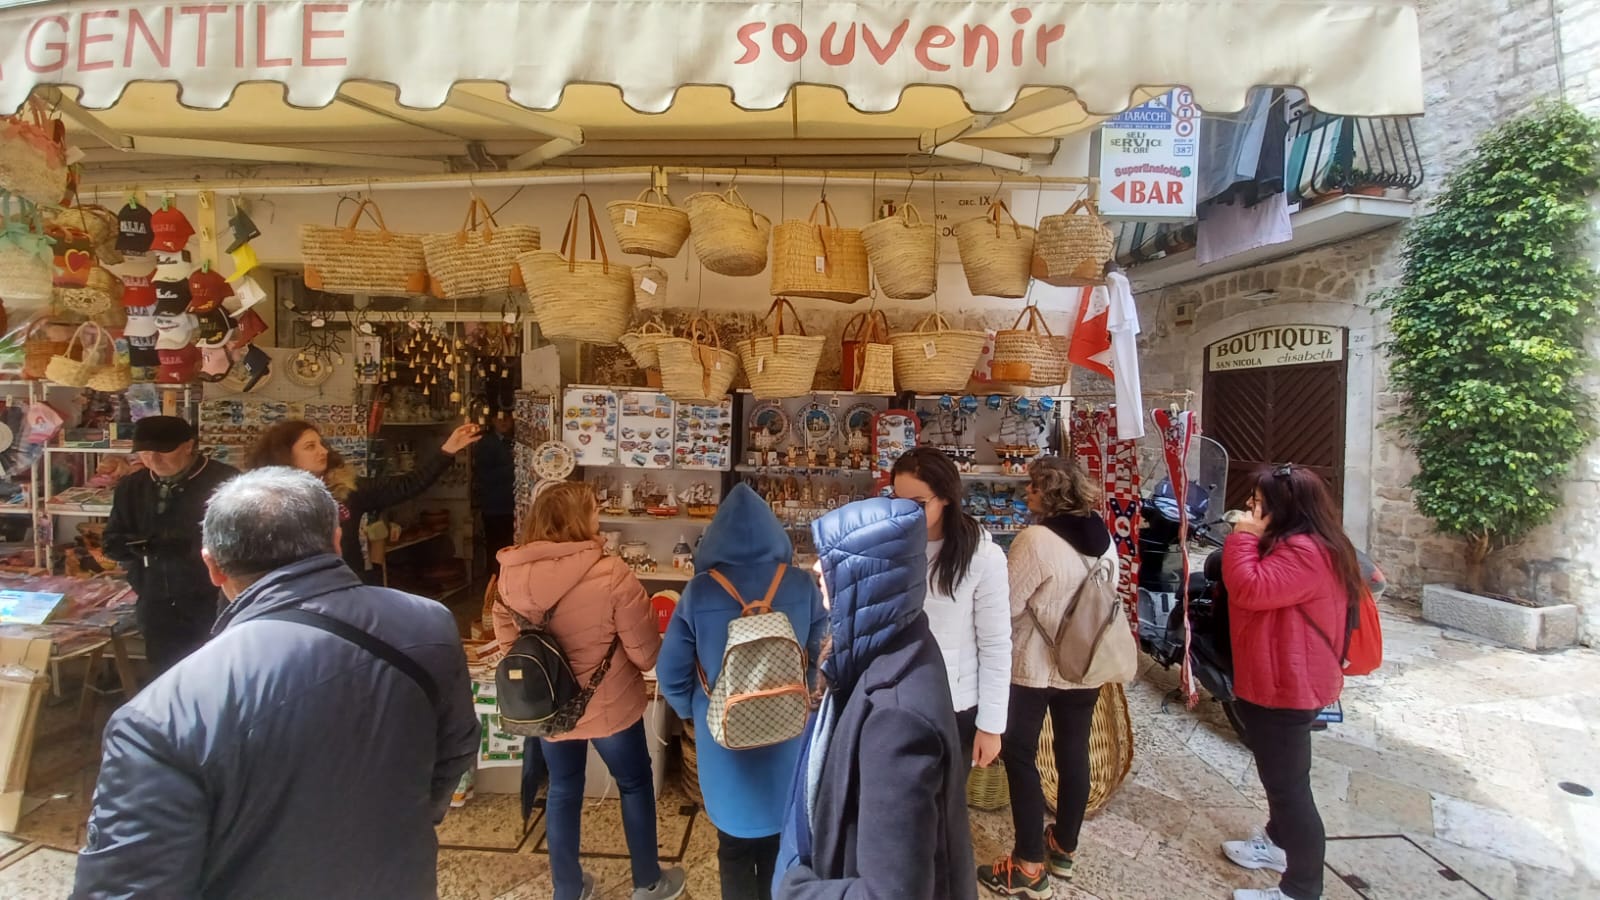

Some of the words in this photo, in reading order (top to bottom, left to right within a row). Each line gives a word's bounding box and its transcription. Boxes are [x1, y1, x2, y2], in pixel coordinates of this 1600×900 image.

[25, 4, 348, 73] GENTILE
[734, 8, 1065, 73] souvenir
[1183, 94, 1189, 103] T
[1124, 111, 1167, 121] TABACCHI
[1182, 108, 1189, 118] T
[1110, 138, 1162, 147] SERVICE
[1130, 181, 1184, 204] BAR
[980, 196, 991, 206] IX
[1216, 327, 1333, 357] BOUTIQUE
[1277, 348, 1333, 364] elisabeth
[1216, 361, 1231, 369] SAN
[1232, 358, 1262, 367] NICOLA
